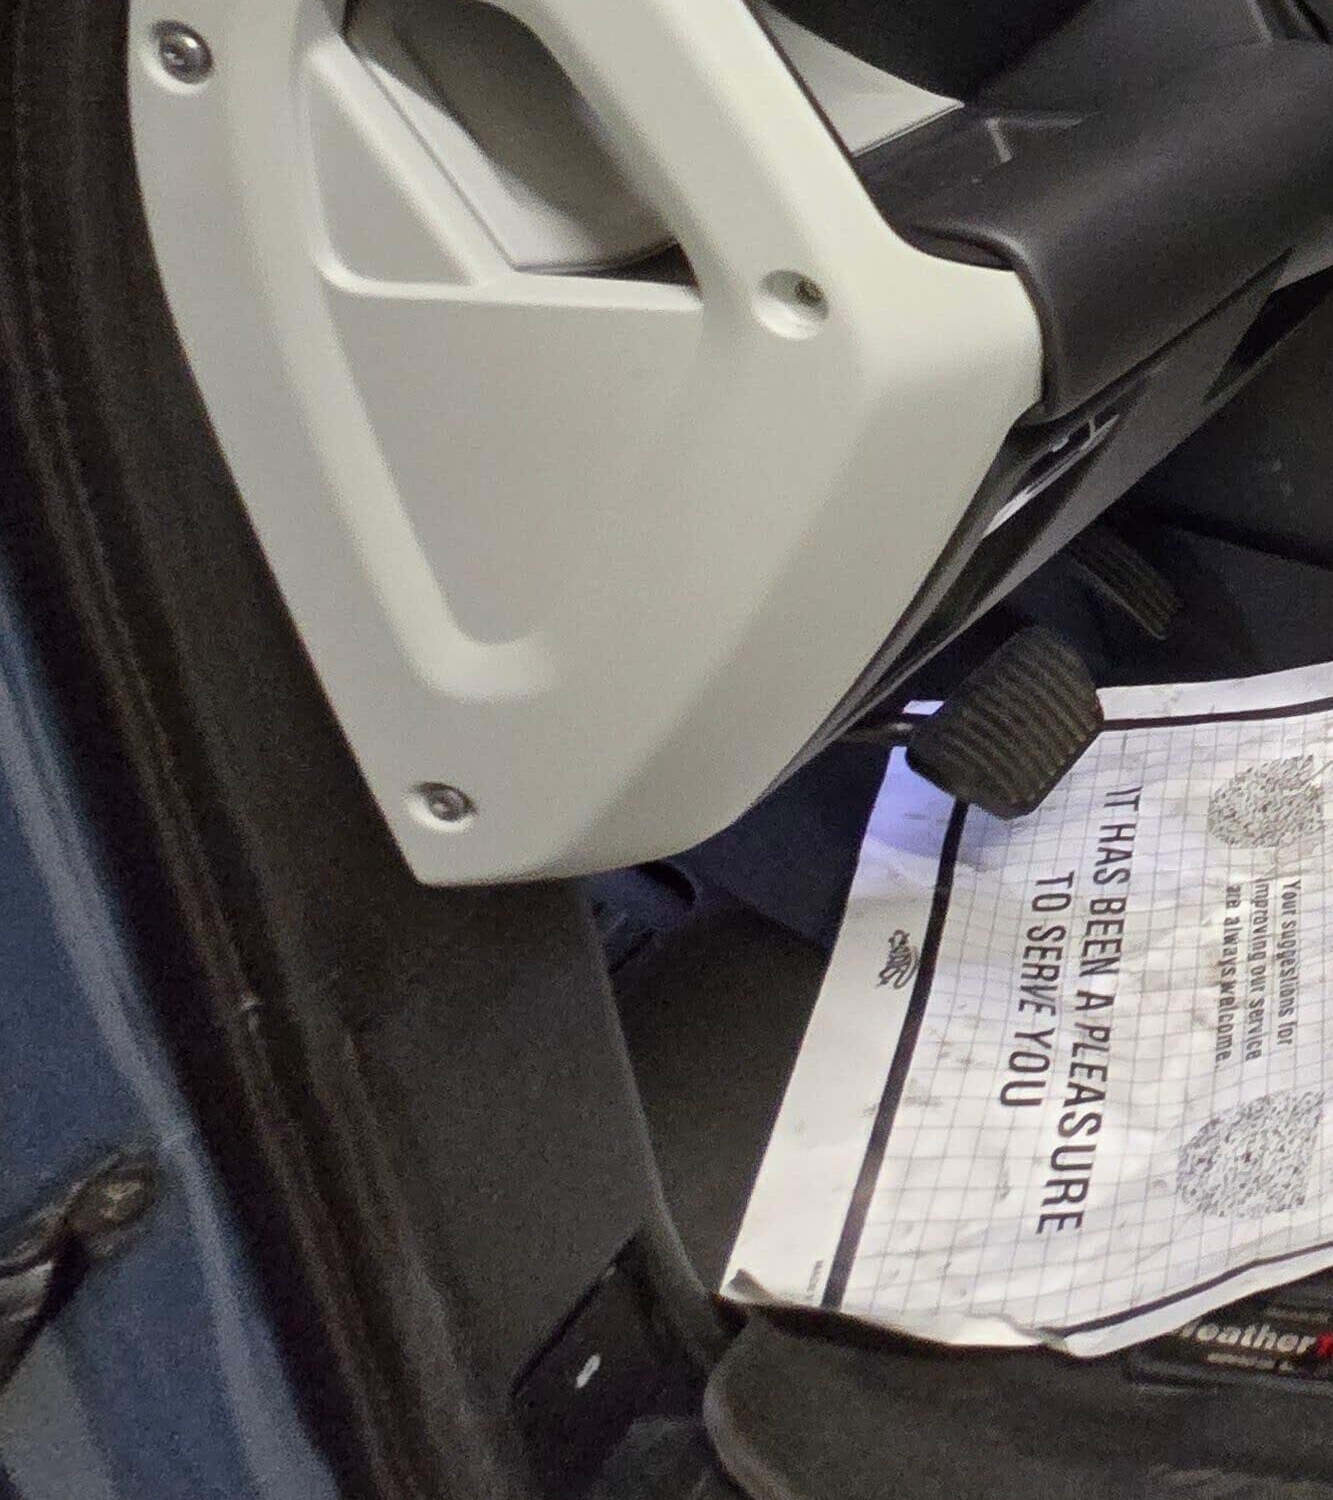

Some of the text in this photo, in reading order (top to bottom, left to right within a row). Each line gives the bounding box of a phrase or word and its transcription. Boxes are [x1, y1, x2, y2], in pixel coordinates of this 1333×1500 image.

[1218, 915, 1243, 978] always
[1225, 883, 1242, 910] are
[1245, 878, 1270, 1062] improving our service
[1276, 878, 1302, 1046] Your suggestions for
[999, 870, 1076, 1108] TO SERVE YOU
[1035, 785, 1142, 1236] IT HAS BEEN A PLEASURE
